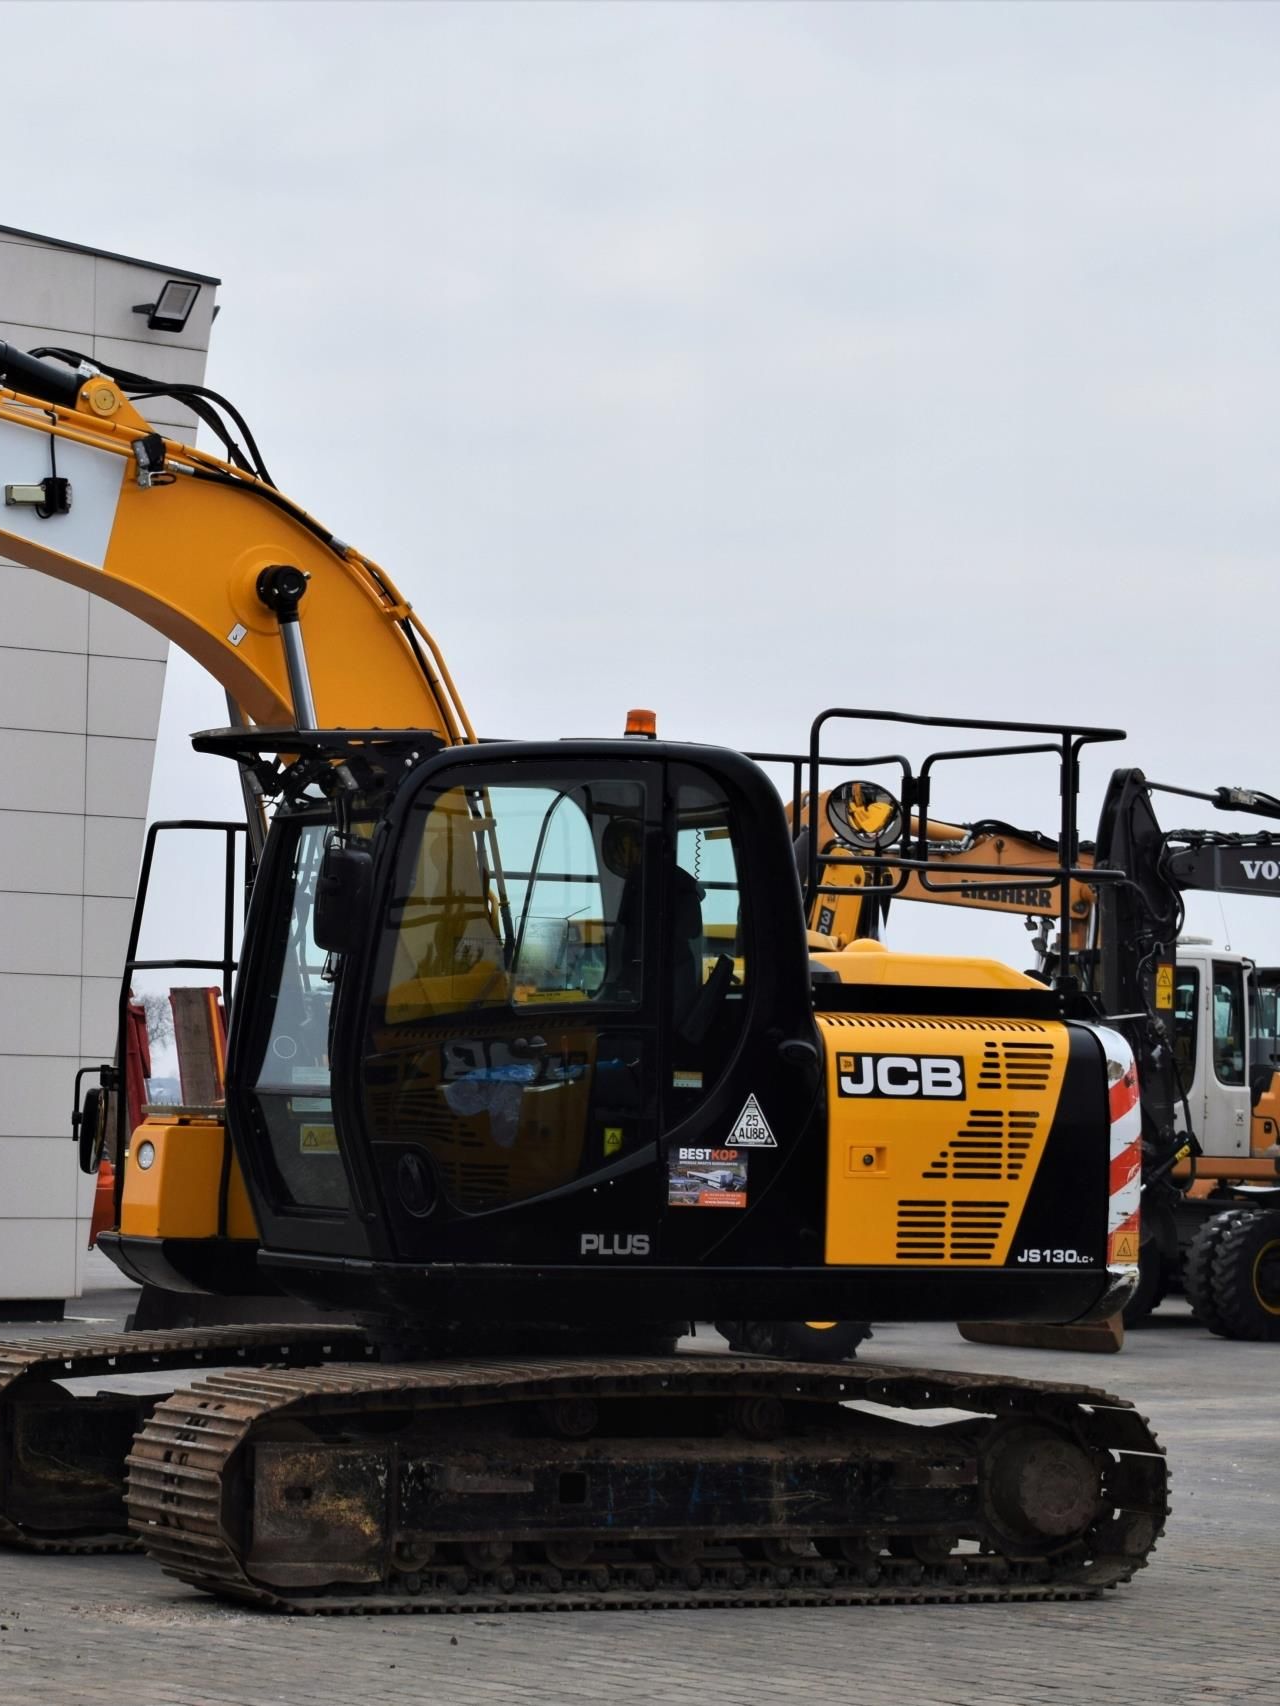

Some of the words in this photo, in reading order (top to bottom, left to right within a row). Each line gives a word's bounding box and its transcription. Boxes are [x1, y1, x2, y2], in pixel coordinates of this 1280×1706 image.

[1240, 860, 1280, 880] VO
[840, 1056, 963, 1097] JCB
[746, 1114, 759, 1127] 25
[679, 1148, 738, 1161] BESTKOP
[581, 1233, 650, 1255] PLUS
